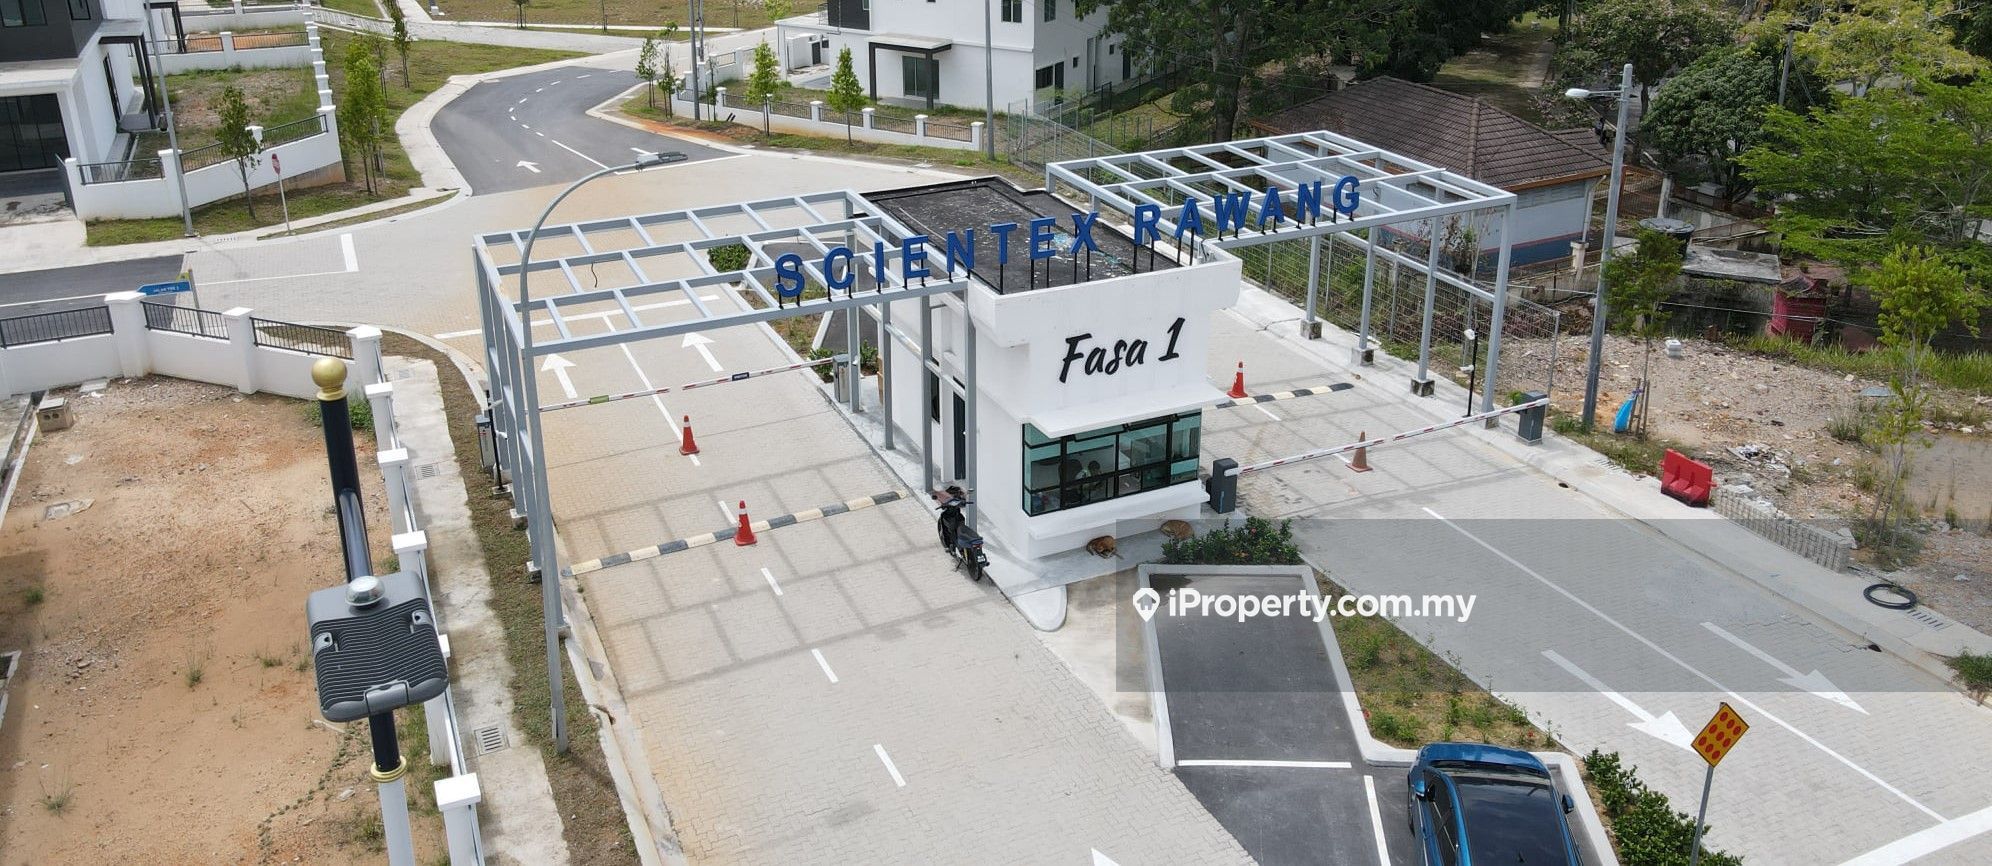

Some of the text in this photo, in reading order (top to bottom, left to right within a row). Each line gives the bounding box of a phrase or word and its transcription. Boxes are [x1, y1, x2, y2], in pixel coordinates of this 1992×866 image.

[774, 175, 1361, 298] SCIENTEX RAWANG
[1059, 317, 1185, 383] Fasa 1
